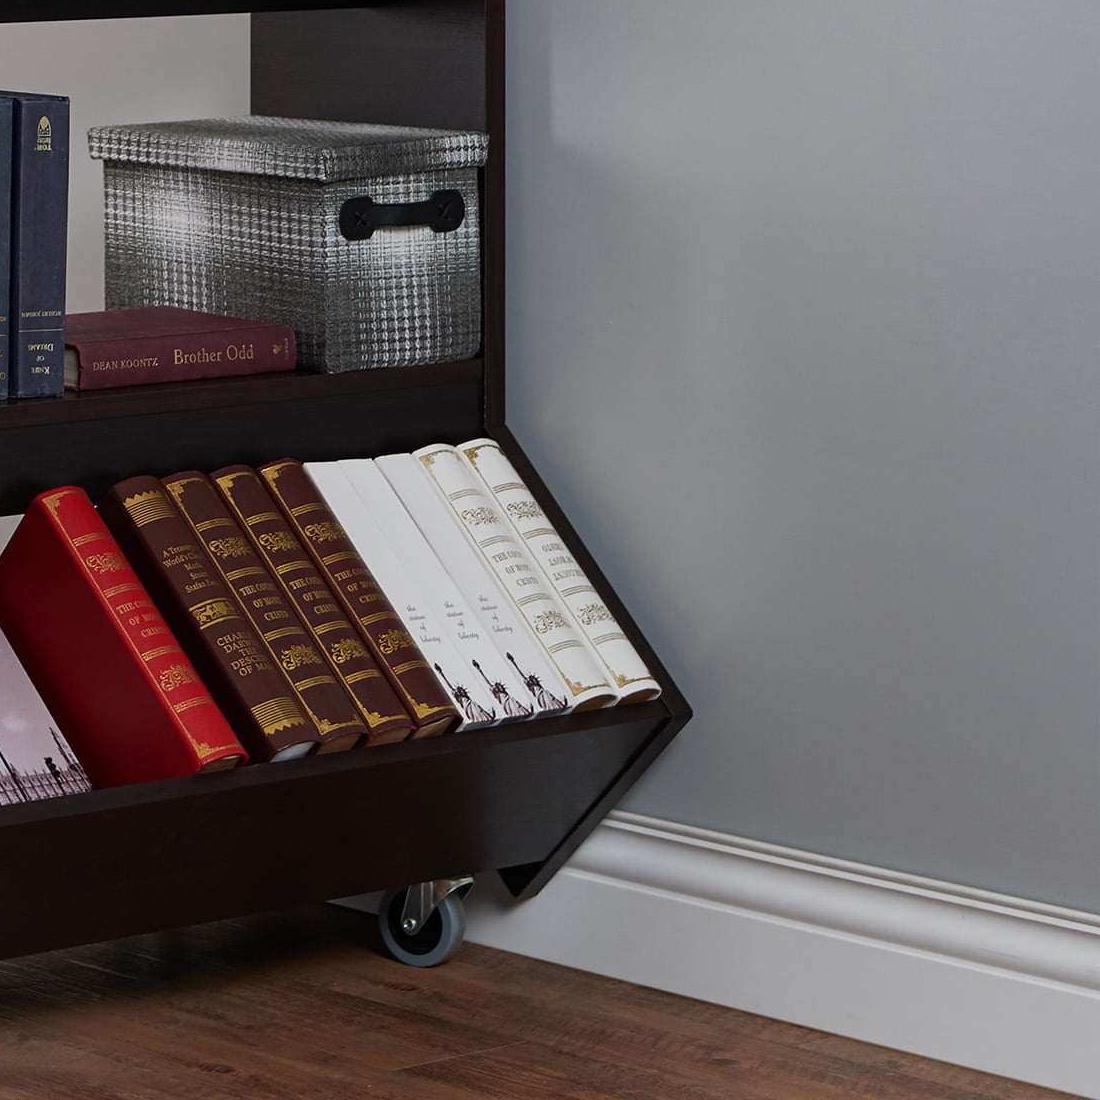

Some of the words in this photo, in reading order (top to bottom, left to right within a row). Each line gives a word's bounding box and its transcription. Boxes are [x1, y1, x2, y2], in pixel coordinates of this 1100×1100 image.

[21, 310, 41, 318] JORDAN
[27, 343, 54, 352] DREAMS
[92, 359, 118, 372] DEAN
[120, 356, 159, 369] KOONTZ
[173, 346, 223, 366] Brother
[226, 343, 254, 361] Odd
[163, 554, 188, 569] World's
[492, 551, 508, 563] THE
[505, 564, 516, 575] OF
[334, 570, 352, 581] THE
[289, 578, 306, 590] THE
[347, 583, 358, 592] OF
[239, 585, 257, 597] THE
[302, 592, 313, 602] OF
[252, 598, 265, 609] OF
[128, 615, 141, 626] OF
[216, 631, 251, 647] CHARL
